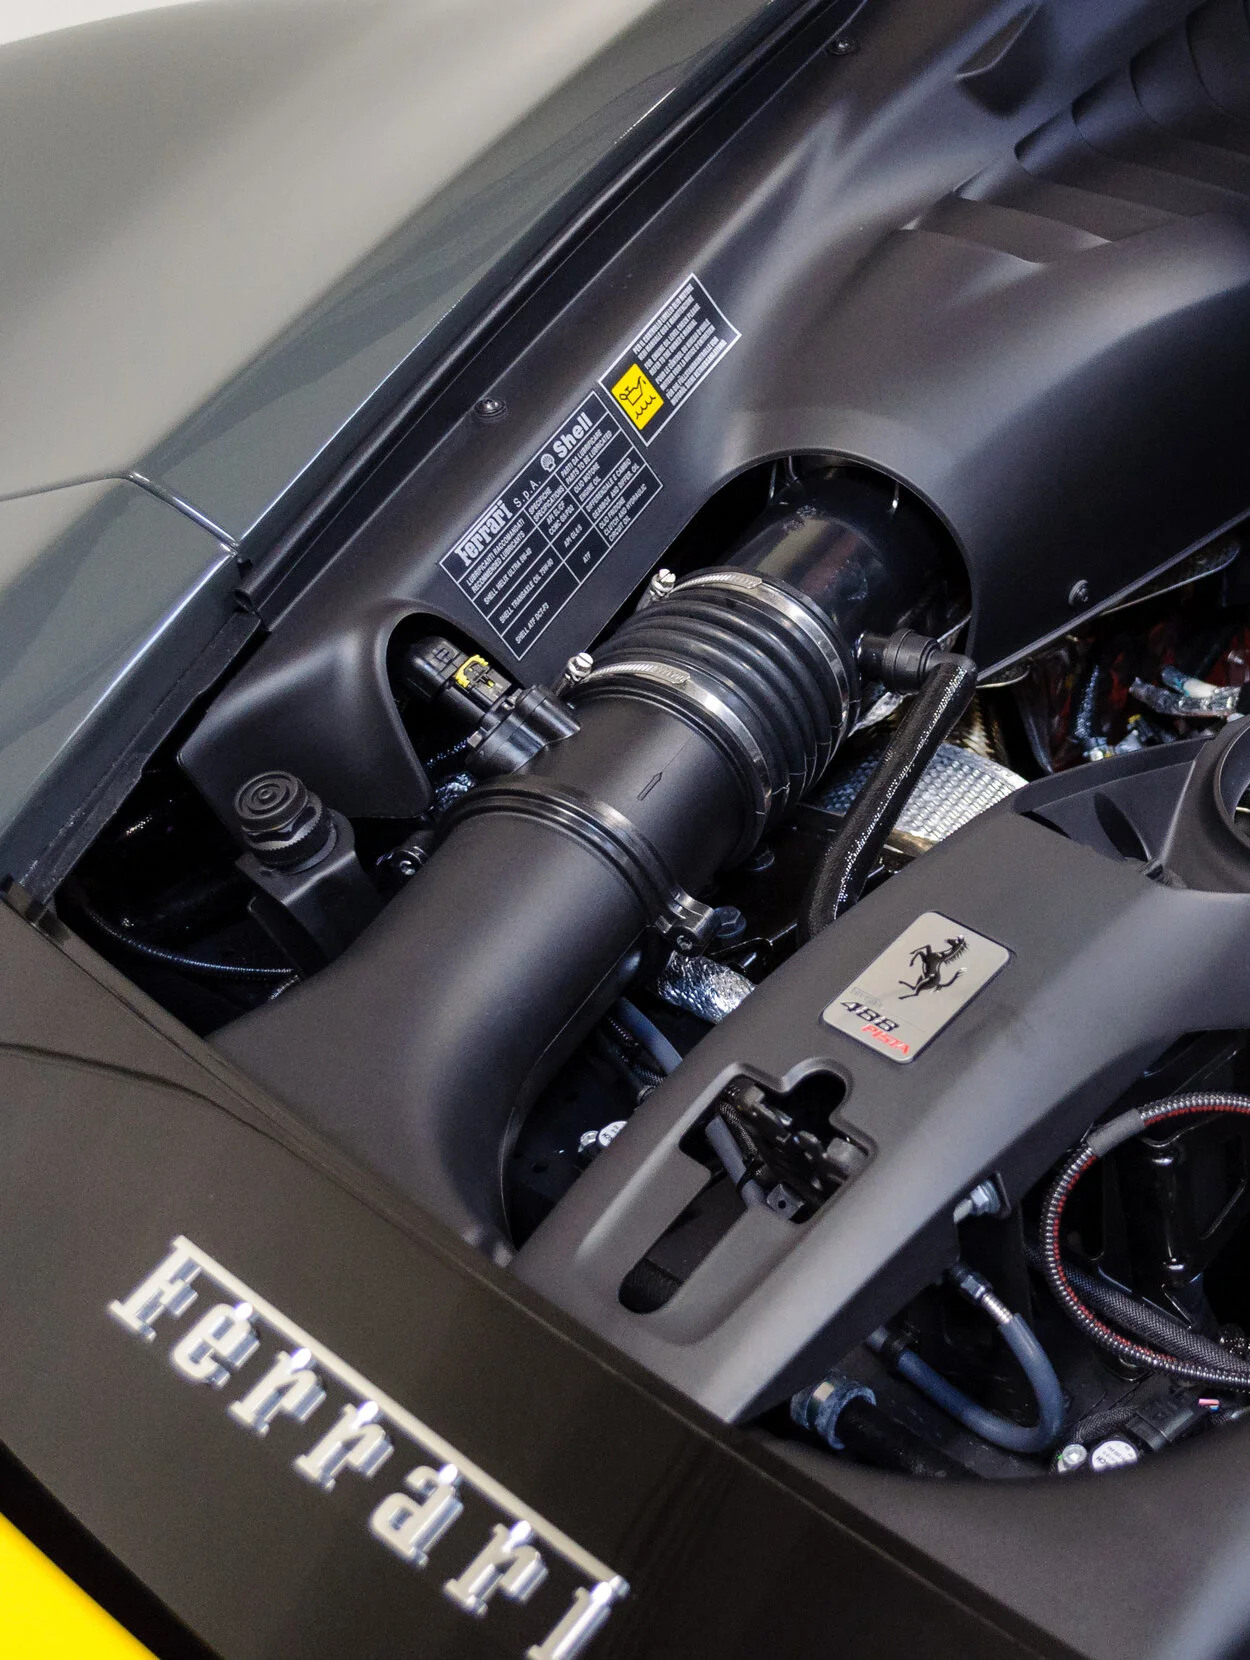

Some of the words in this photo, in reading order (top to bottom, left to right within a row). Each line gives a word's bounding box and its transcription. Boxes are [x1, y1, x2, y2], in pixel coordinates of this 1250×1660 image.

[553, 412, 593, 458] Shell
[561, 462, 573, 478] PARTI
[571, 456, 579, 466] DA
[577, 429, 602, 459] LUBRIFICARE
[565, 468, 579, 485] PARTS
[577, 461, 585, 470] TO
[583, 455, 591, 465] BE
[589, 430, 612, 458] LUBRICATED
[574, 480, 584, 493] OLIO
[583, 462, 600, 483] MOTORE
[528, 487, 552, 515] SPECIFICHE
[533, 485, 564, 522] SPECIFICATIONS
[579, 482, 595, 502] ENGINE
[593, 476, 601, 485] OIL
[586, 478, 614, 512] DIFFERENZIALE
[616, 458, 631, 477] CAMBIO
[592, 496, 611, 519] GEARBOX
[610, 486, 619, 498] AND
[631, 463, 640, 473] OIL
[454, 500, 513, 567] Ferrari
[513, 480, 543, 508] S.p.A.
[546, 513, 555, 525] API
[599, 516, 609, 529] OLIO
[607, 496, 625, 519] FRIZIONE
[604, 516, 620, 536] CLUTCH
[618, 507, 627, 519] AND
[626, 484, 647, 510] HYDRAULIC
[609, 522, 624, 542] CIRCUIT
[623, 515, 631, 525] OIL
[466, 552, 495, 586] LUBRIFICANTI
[493, 518, 525, 555] RACCOMANDATI
[471, 557, 502, 593] RECOMMENDED
[500, 530, 525, 560] LUBRICANTS
[564, 536, 572, 548] API
[583, 551, 591, 563] ATF
[484, 588, 498, 605] SHELL
[496, 574, 509, 590] HELIX
[507, 560, 521, 577] ULTRA
[499, 607, 514, 624] SHELL
[511, 580, 535, 608] TRANSAXLE
[533, 574, 541, 584] OIL
[515, 627, 529, 644] SHELL
[840, 1002, 899, 1032] 488
[861, 1024, 910, 1055] PISTA
[107, 1234, 630, 1660] Ferrari
